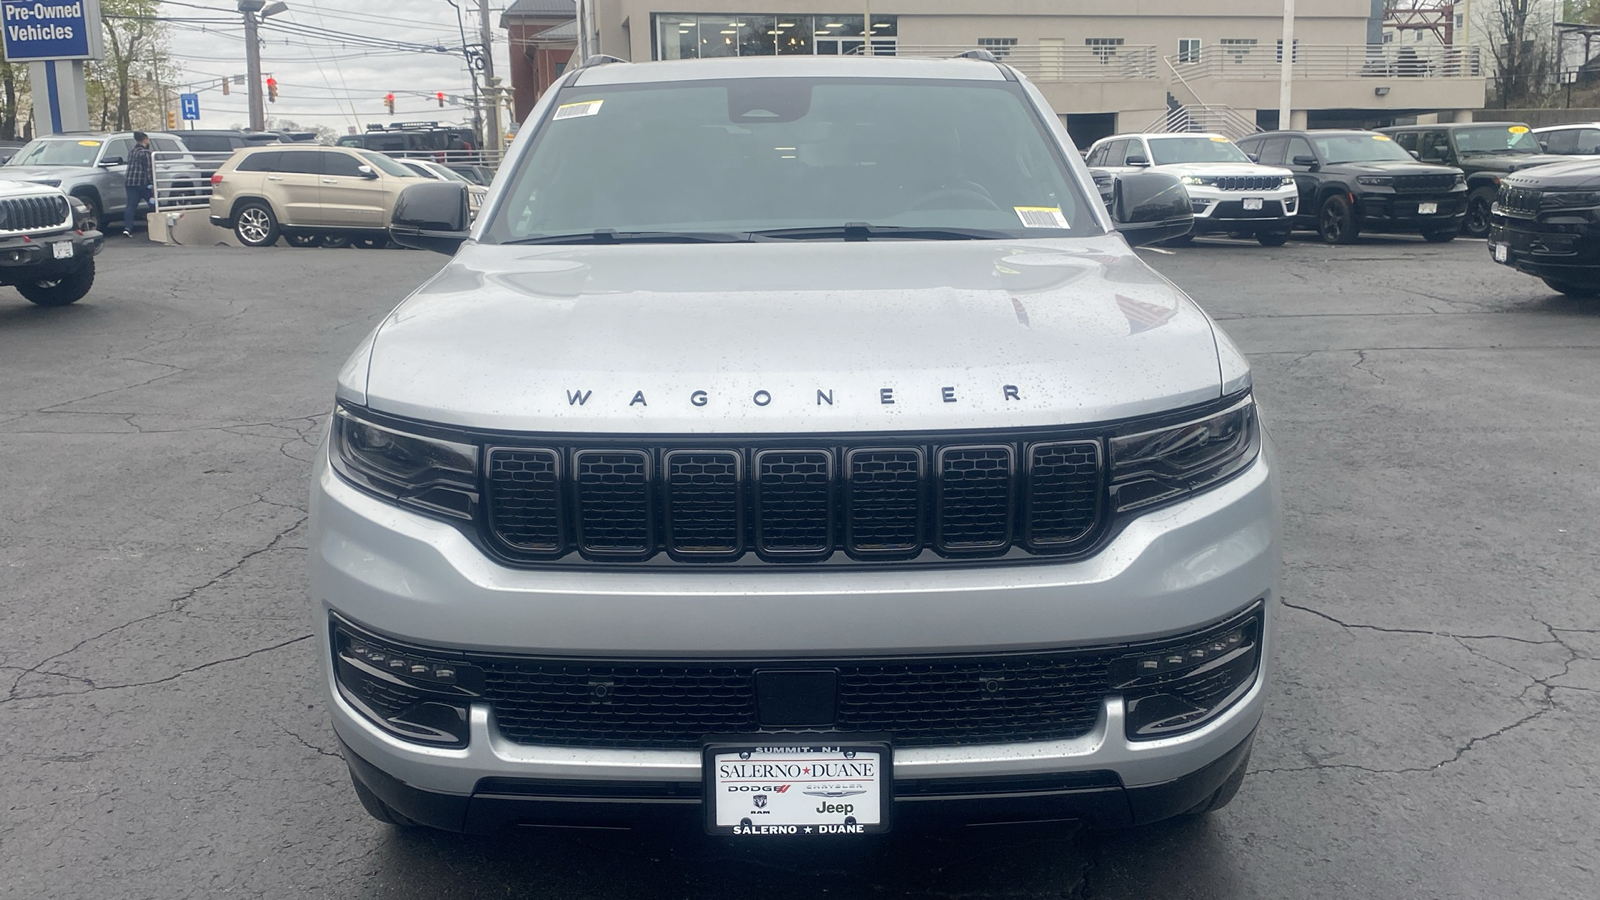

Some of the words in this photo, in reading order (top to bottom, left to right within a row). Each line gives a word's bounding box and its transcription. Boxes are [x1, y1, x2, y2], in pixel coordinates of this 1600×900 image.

[5, 1, 82, 20] Pre-Owned
[8, 23, 74, 41] Vehicles
[184, 99, 195, 113] H
[567, 384, 1021, 407] WAGONEER
[821, 746, 841, 754] NJ
[720, 764, 800, 779] SALERNO
[812, 763, 874, 778] DUANE
[816, 801, 854, 816] Jeep
[733, 825, 797, 834] SALERNO
[819, 824, 864, 834] DUANE
